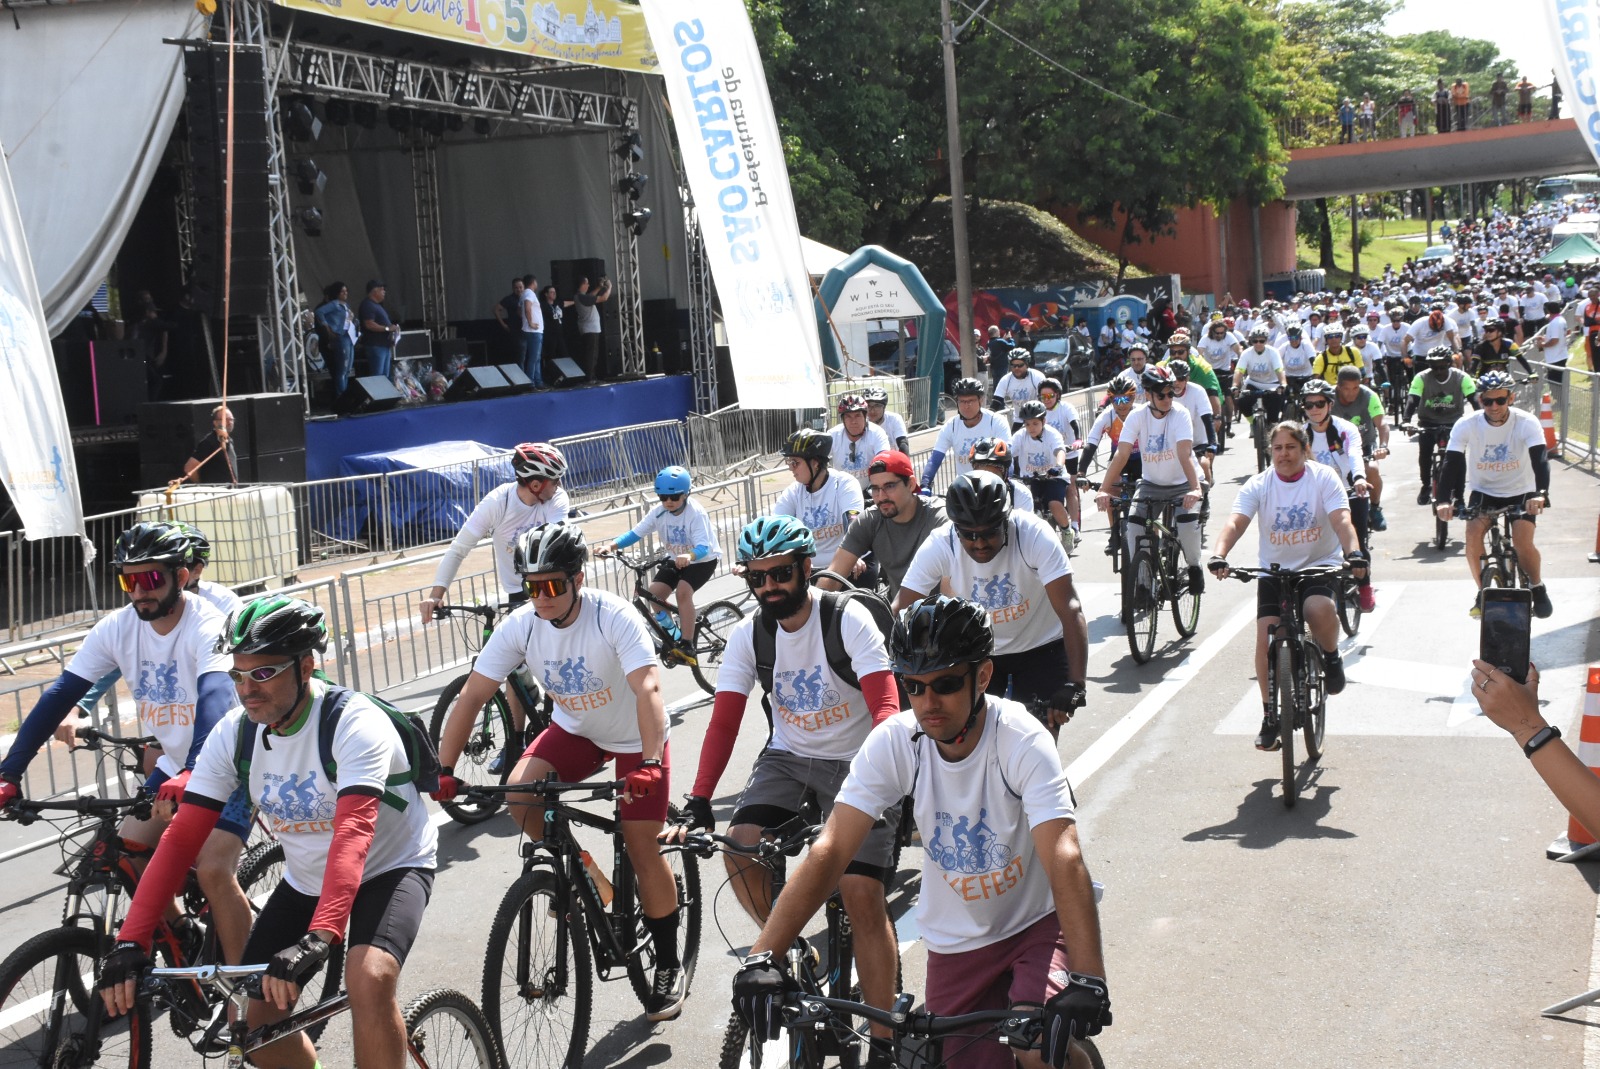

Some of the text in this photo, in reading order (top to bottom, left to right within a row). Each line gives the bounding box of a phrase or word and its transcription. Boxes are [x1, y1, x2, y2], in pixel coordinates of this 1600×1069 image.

[464, 0, 528, 46] 165
[850, 290, 899, 302] WISH
[1476, 459, 1521, 472] BIKEFEST
[1269, 526, 1323, 547] BIKEFEST
